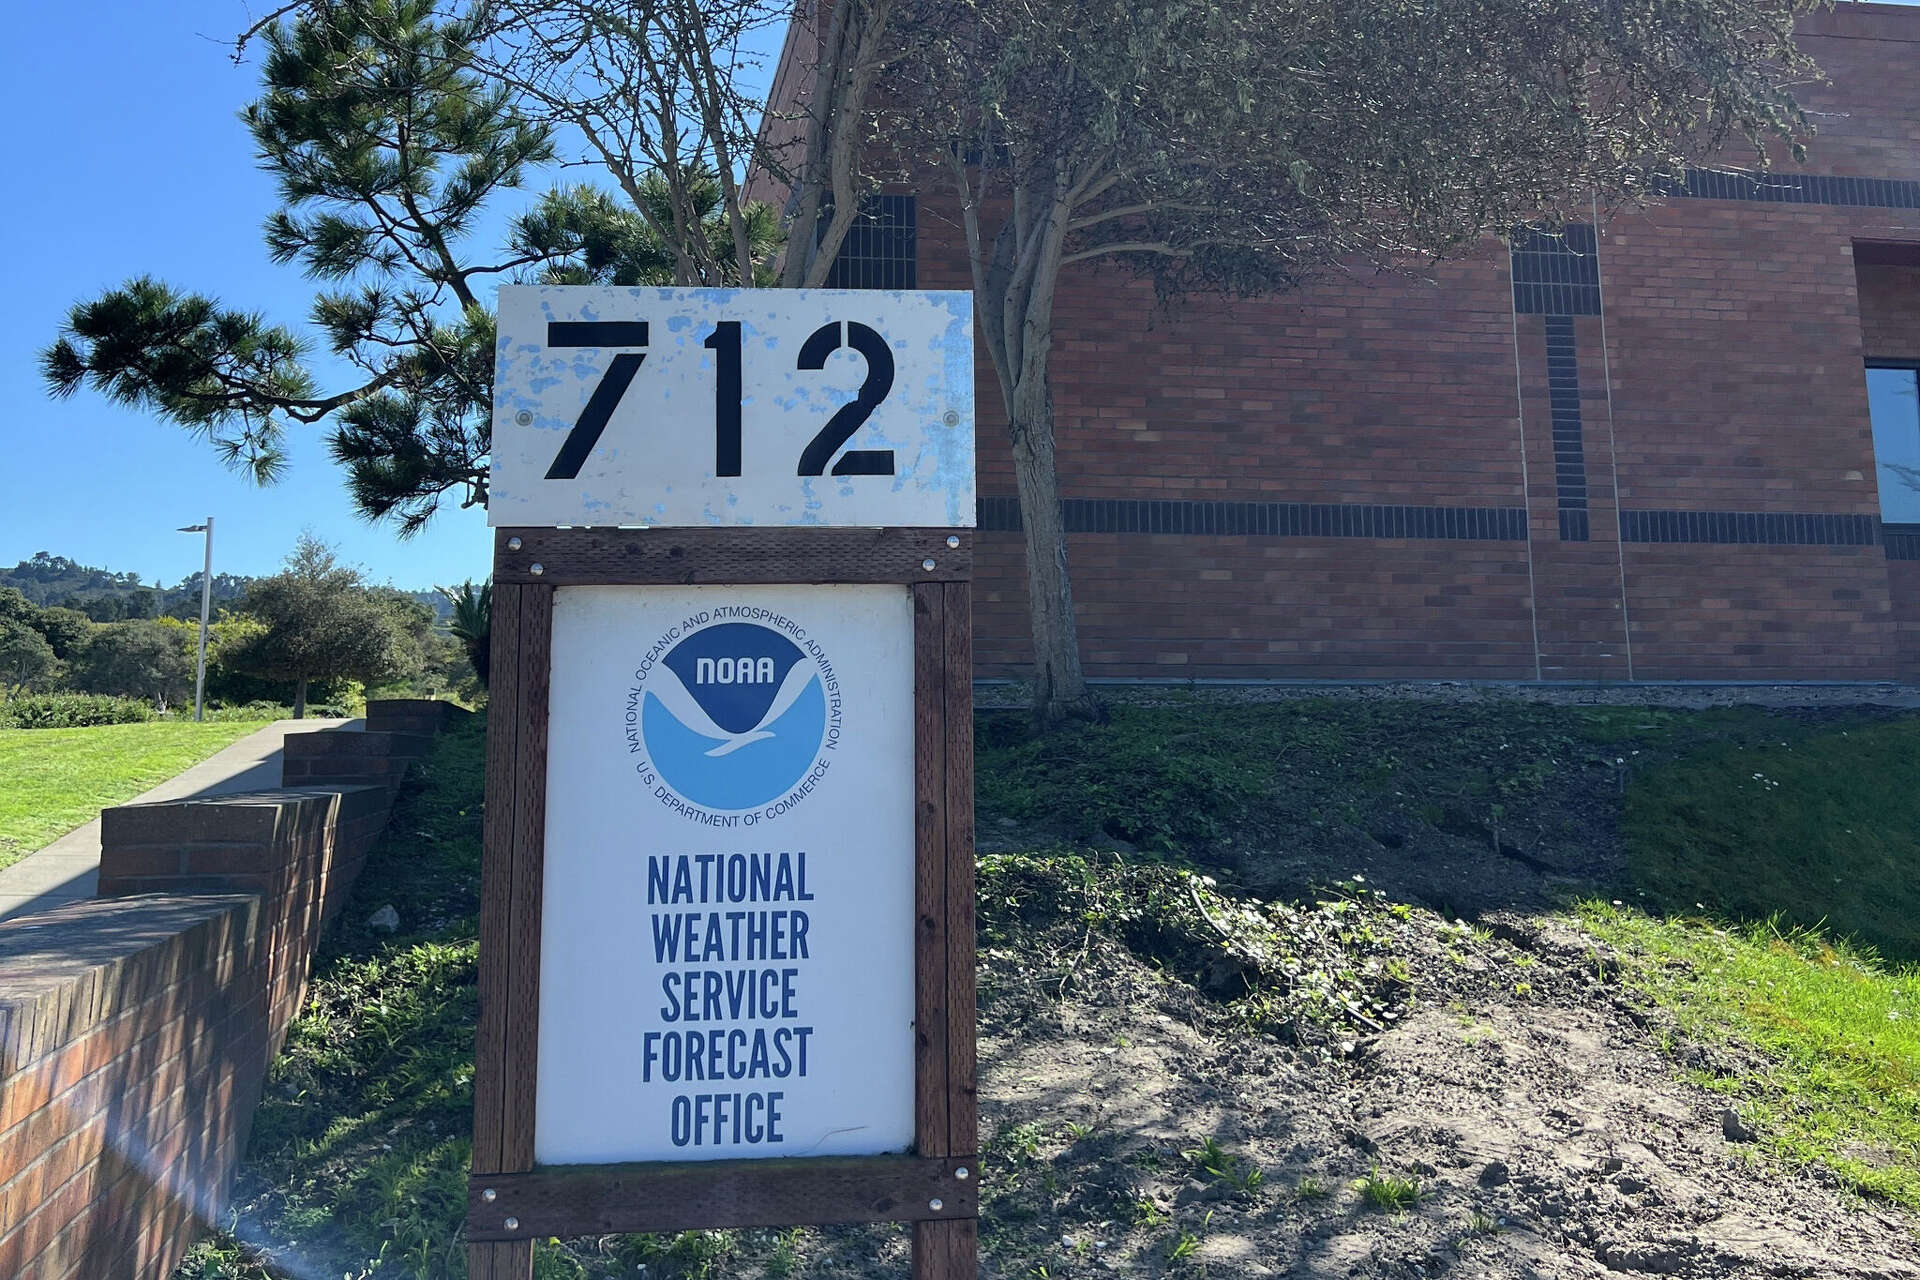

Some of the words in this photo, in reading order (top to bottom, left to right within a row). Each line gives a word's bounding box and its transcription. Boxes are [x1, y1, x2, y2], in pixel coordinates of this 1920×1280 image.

[544, 320, 895, 479] 712
[625, 684, 643, 753] NATIONAL
[635, 626, 681, 682] OCEANIC
[682, 610, 710, 632] AND
[713, 606, 808, 641] ATMOSPHERIC
[803, 638, 842, 750] ADMINISTRATION
[696, 657, 774, 685] NOAA
[636, 761, 656, 789] U.S.
[654, 785, 740, 828] DEPARTMENT
[743, 811, 763, 827] OF
[765, 757, 831, 820] COMMERCE
[647, 852, 814, 905] NATIONAL
[651, 910, 810, 963] WEATHER
[660, 968, 799, 1022] SERVICE
[642, 1027, 813, 1083] FORECAST
[671, 1092, 784, 1147] OFFICE
